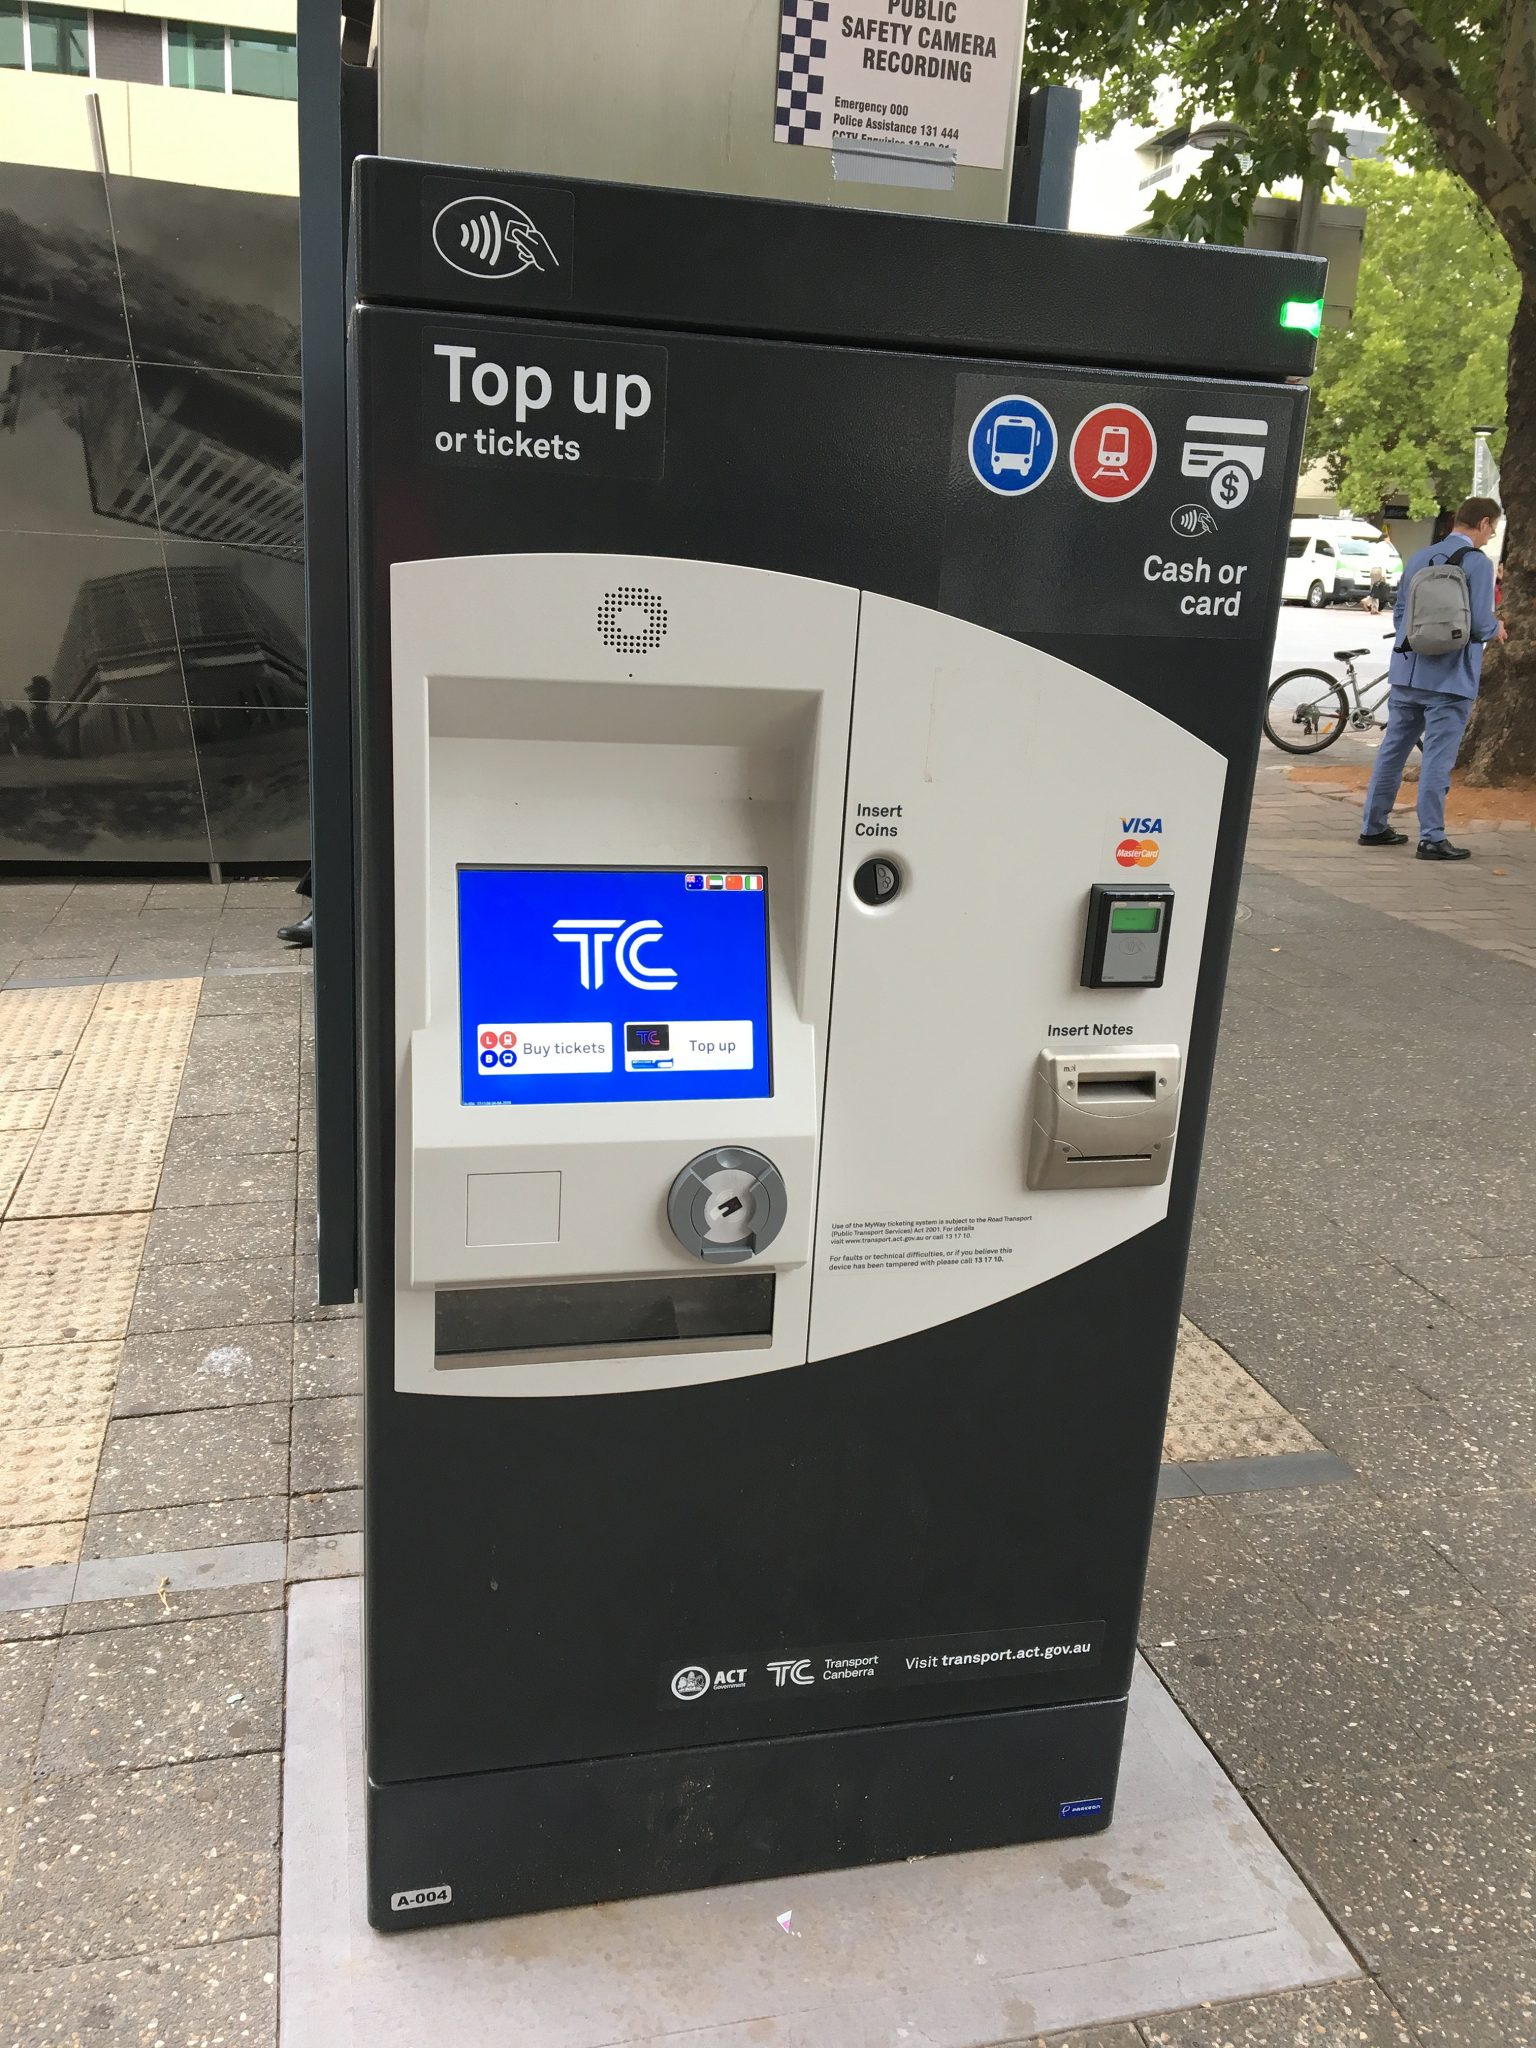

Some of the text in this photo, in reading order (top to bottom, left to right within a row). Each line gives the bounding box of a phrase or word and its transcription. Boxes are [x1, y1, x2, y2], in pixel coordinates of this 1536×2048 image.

[888, 0, 957, 24] PUBLIC
[841, 15, 997, 59] SAFETY CAMERA
[862, 47, 973, 83] RECORDING
[835, 96, 909, 117] Emergency 000
[833, 113, 960, 140] Police Assistance 131 444
[433, 343, 652, 430] Top up
[435, 428, 581, 461] or tickets
[1143, 555, 1248, 585] Cash or
[1180, 591, 1242, 617] card
[857, 803, 903, 817] Insert
[855, 822, 898, 837] Coins
[1120, 816, 1163, 833] VISA
[1116, 848, 1159, 858] MasterCard
[552, 919, 678, 990] TC
[1047, 1023, 1134, 1037] Insert Notes
[485, 1035, 493, 1045] L
[689, 1039, 736, 1055] Top up
[523, 1041, 606, 1058] Buy tickets
[485, 1054, 494, 1064] B
[864, 1221, 886, 1229] MyWay
[887, 1220, 915, 1228] ticketing
[829, 1263, 852, 1271] device
[885, 1260, 919, 1268] tampered
[936, 1258, 959, 1266] please
[873, 1252, 905, 1260] technical
[824, 1655, 879, 1669] Transport
[905, 1643, 1091, 1670] Visit transport.act.gov.au
[713, 1669, 748, 1684] ACT
[766, 1658, 815, 1687] TC
[823, 1667, 875, 1681] Canberra
[397, 1889, 448, 1907] A-004
